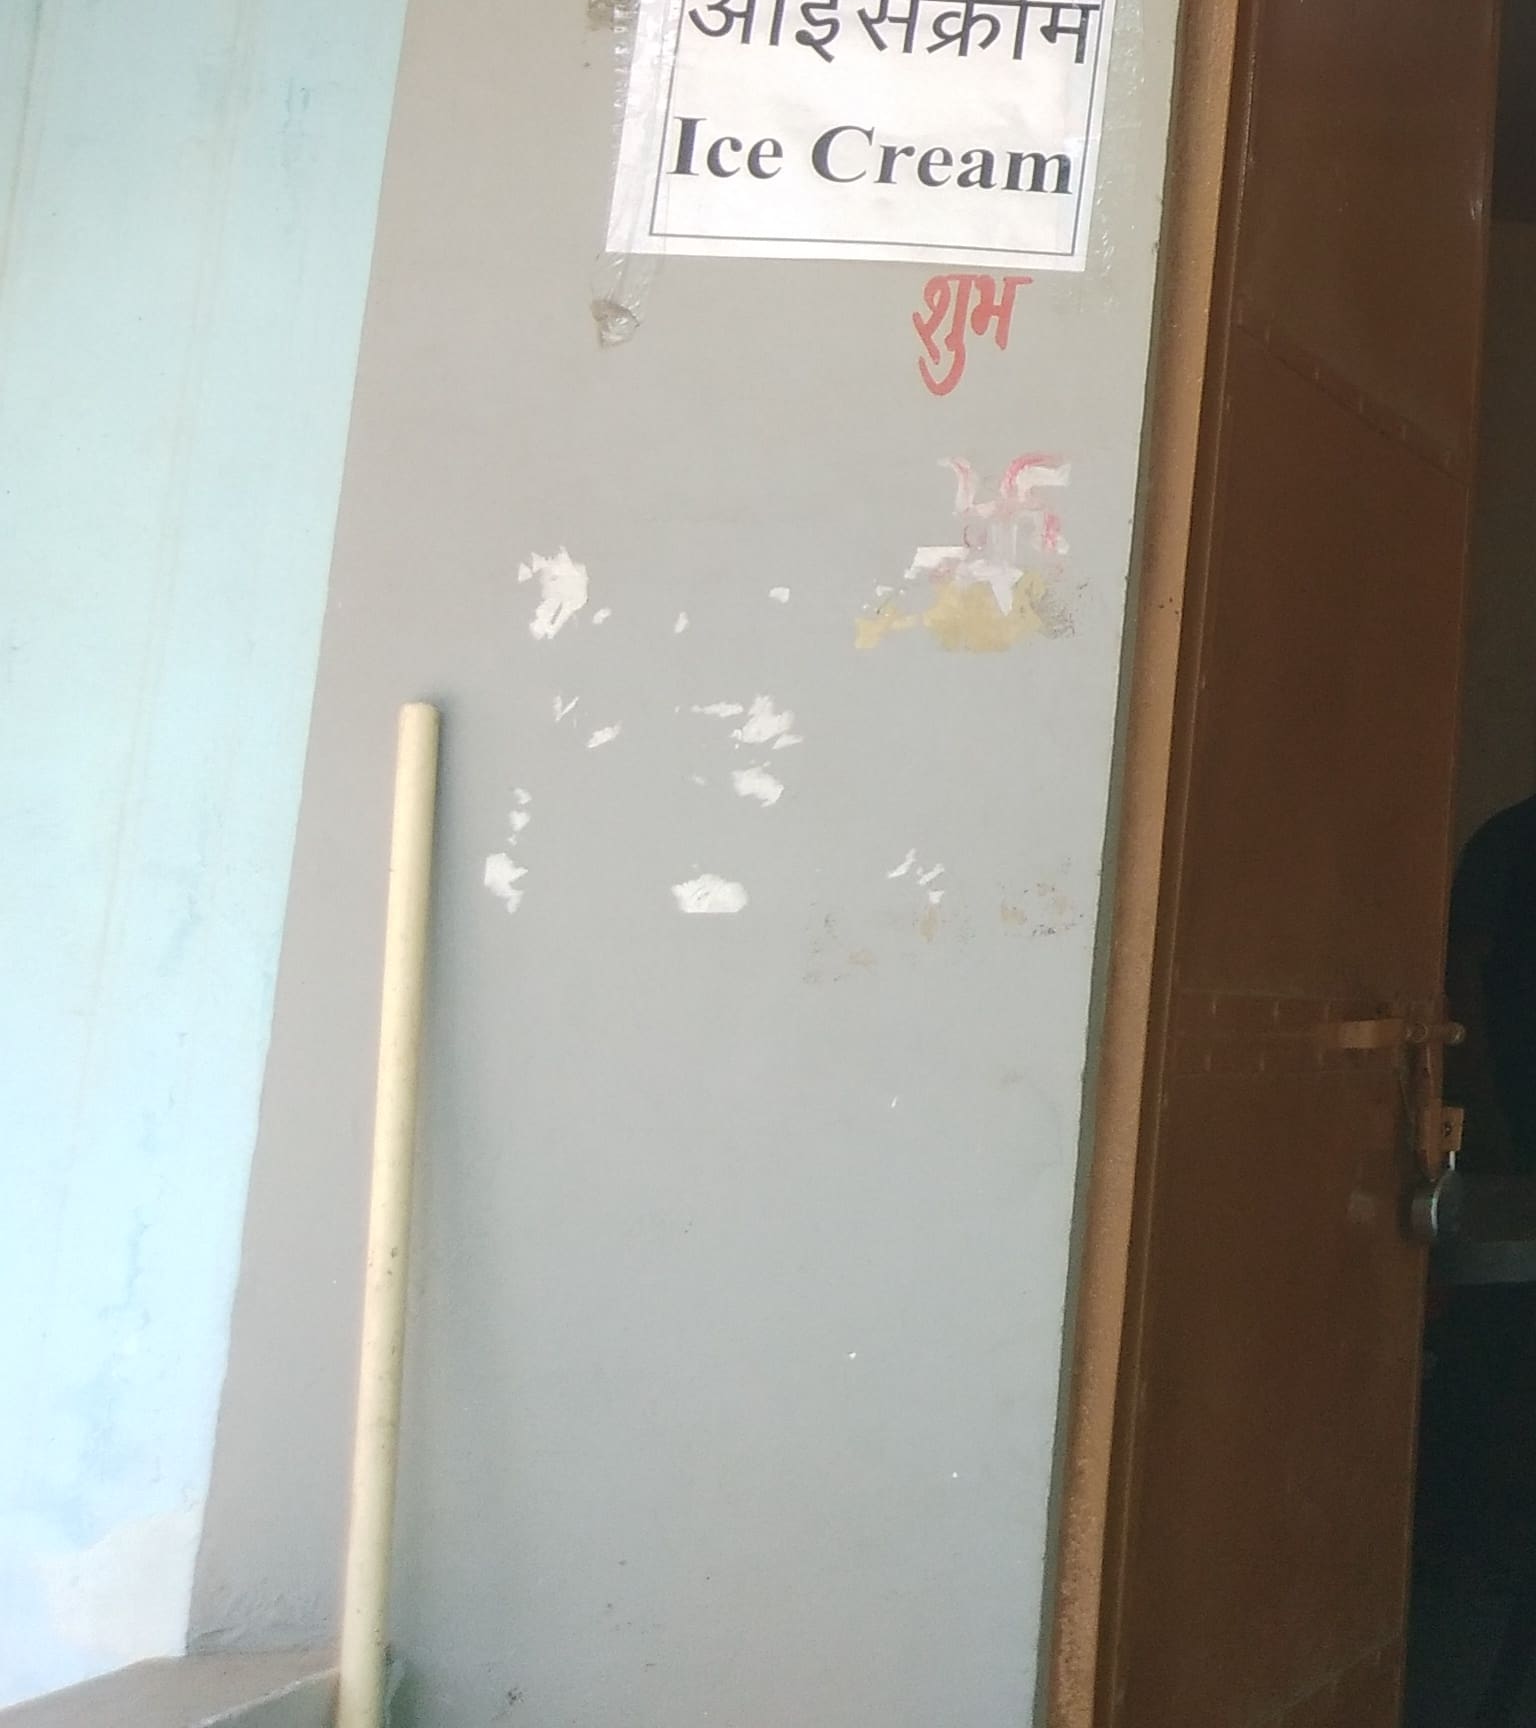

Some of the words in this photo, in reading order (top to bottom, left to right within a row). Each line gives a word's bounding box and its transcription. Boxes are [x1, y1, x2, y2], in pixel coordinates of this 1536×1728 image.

[666, 116, 784, 178] Ice
[811, 124, 1074, 195] Cream
[912, 275, 1032, 395] शुभ
